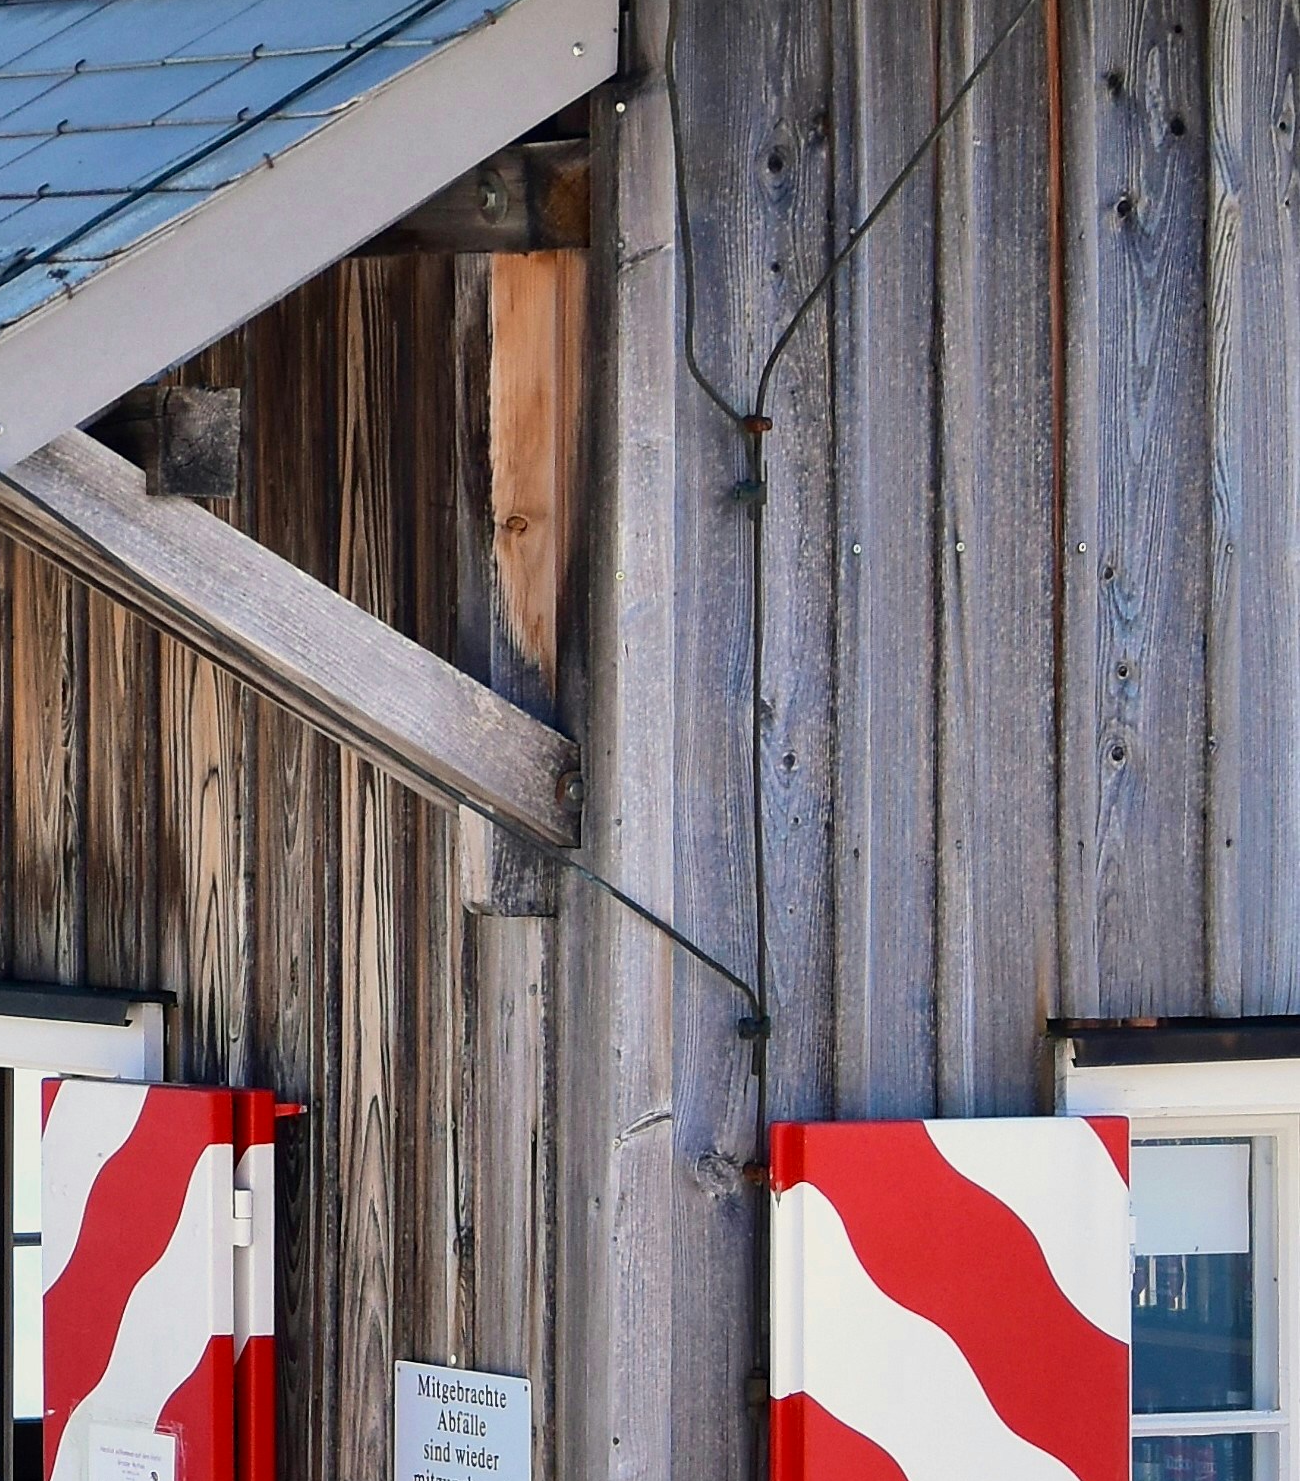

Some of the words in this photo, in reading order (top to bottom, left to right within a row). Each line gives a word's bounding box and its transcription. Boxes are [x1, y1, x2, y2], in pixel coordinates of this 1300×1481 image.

[418, 1374, 507, 1408] Mitgebrachte
[437, 1409, 487, 1437] Abfälle
[423, 1438, 451, 1463] sind
[455, 1444, 500, 1471] wieder
